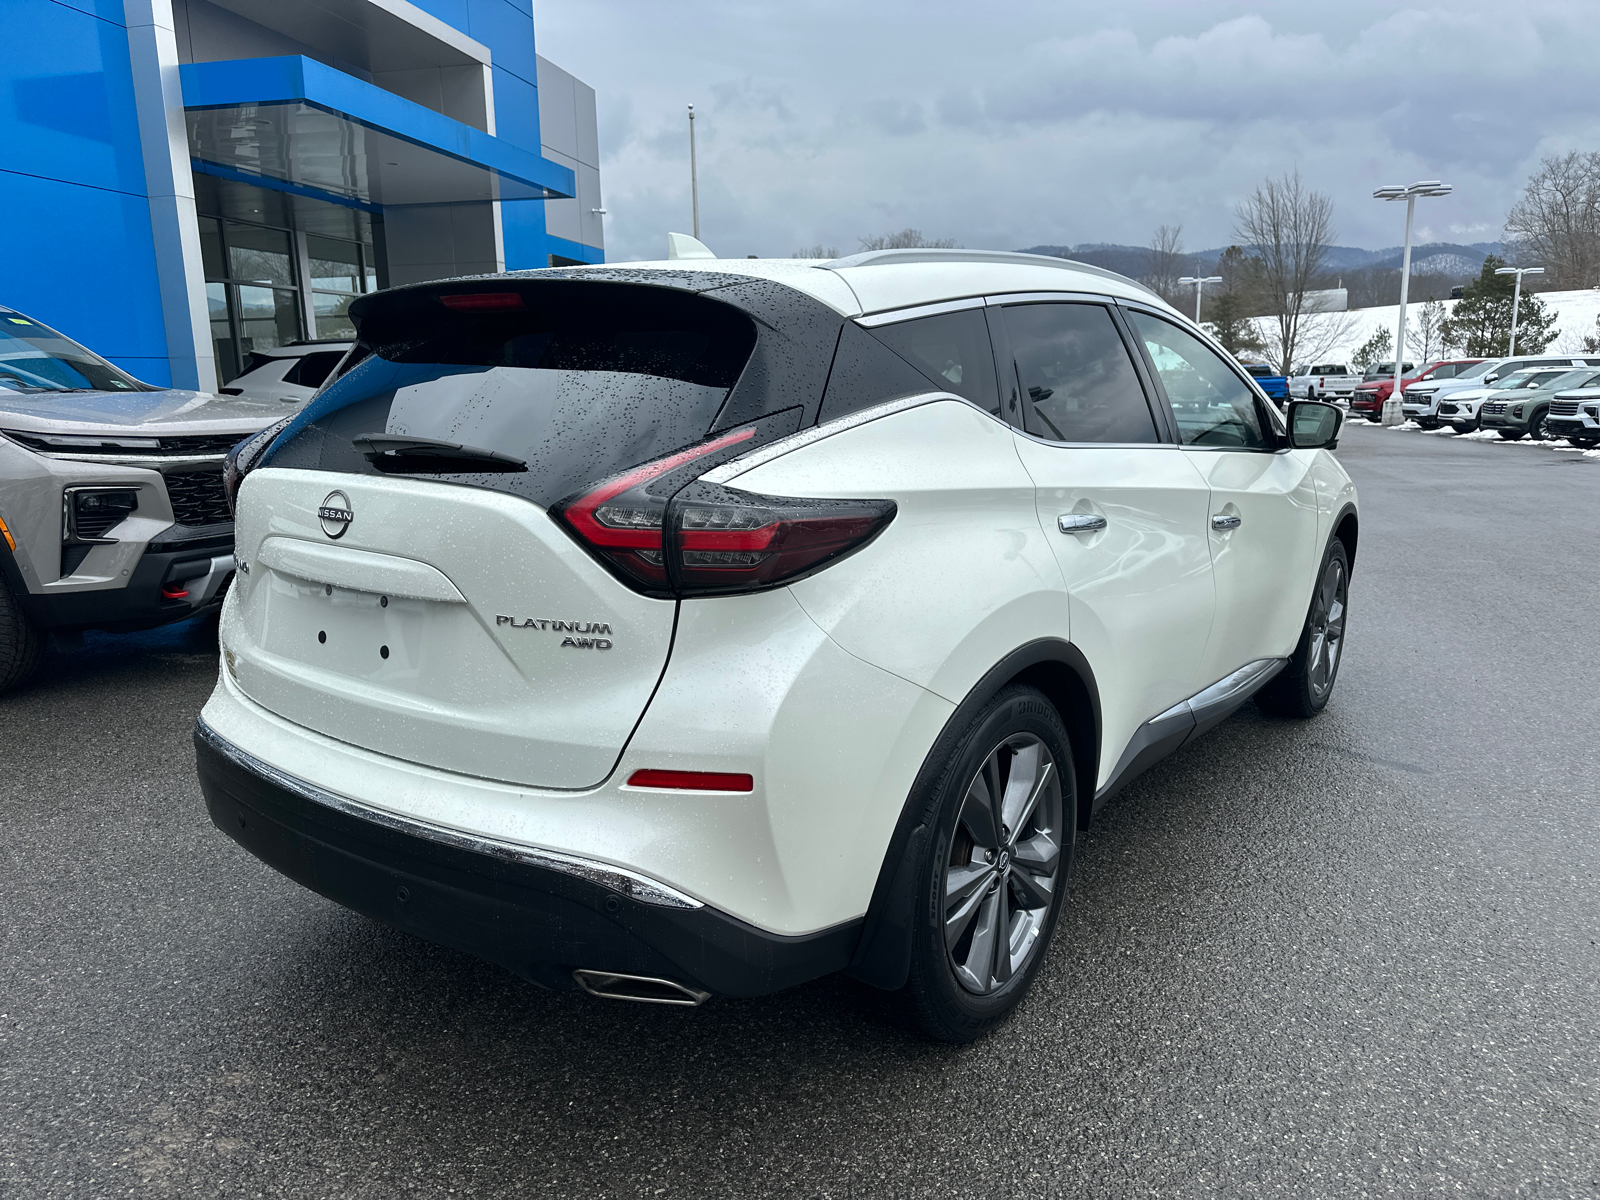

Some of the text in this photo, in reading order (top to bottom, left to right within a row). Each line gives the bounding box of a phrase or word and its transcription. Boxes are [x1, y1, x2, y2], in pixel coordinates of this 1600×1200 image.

[318, 509, 352, 521] NISSAN
[496, 614, 613, 635] PLATINUM
[560, 635, 613, 650] AWD
